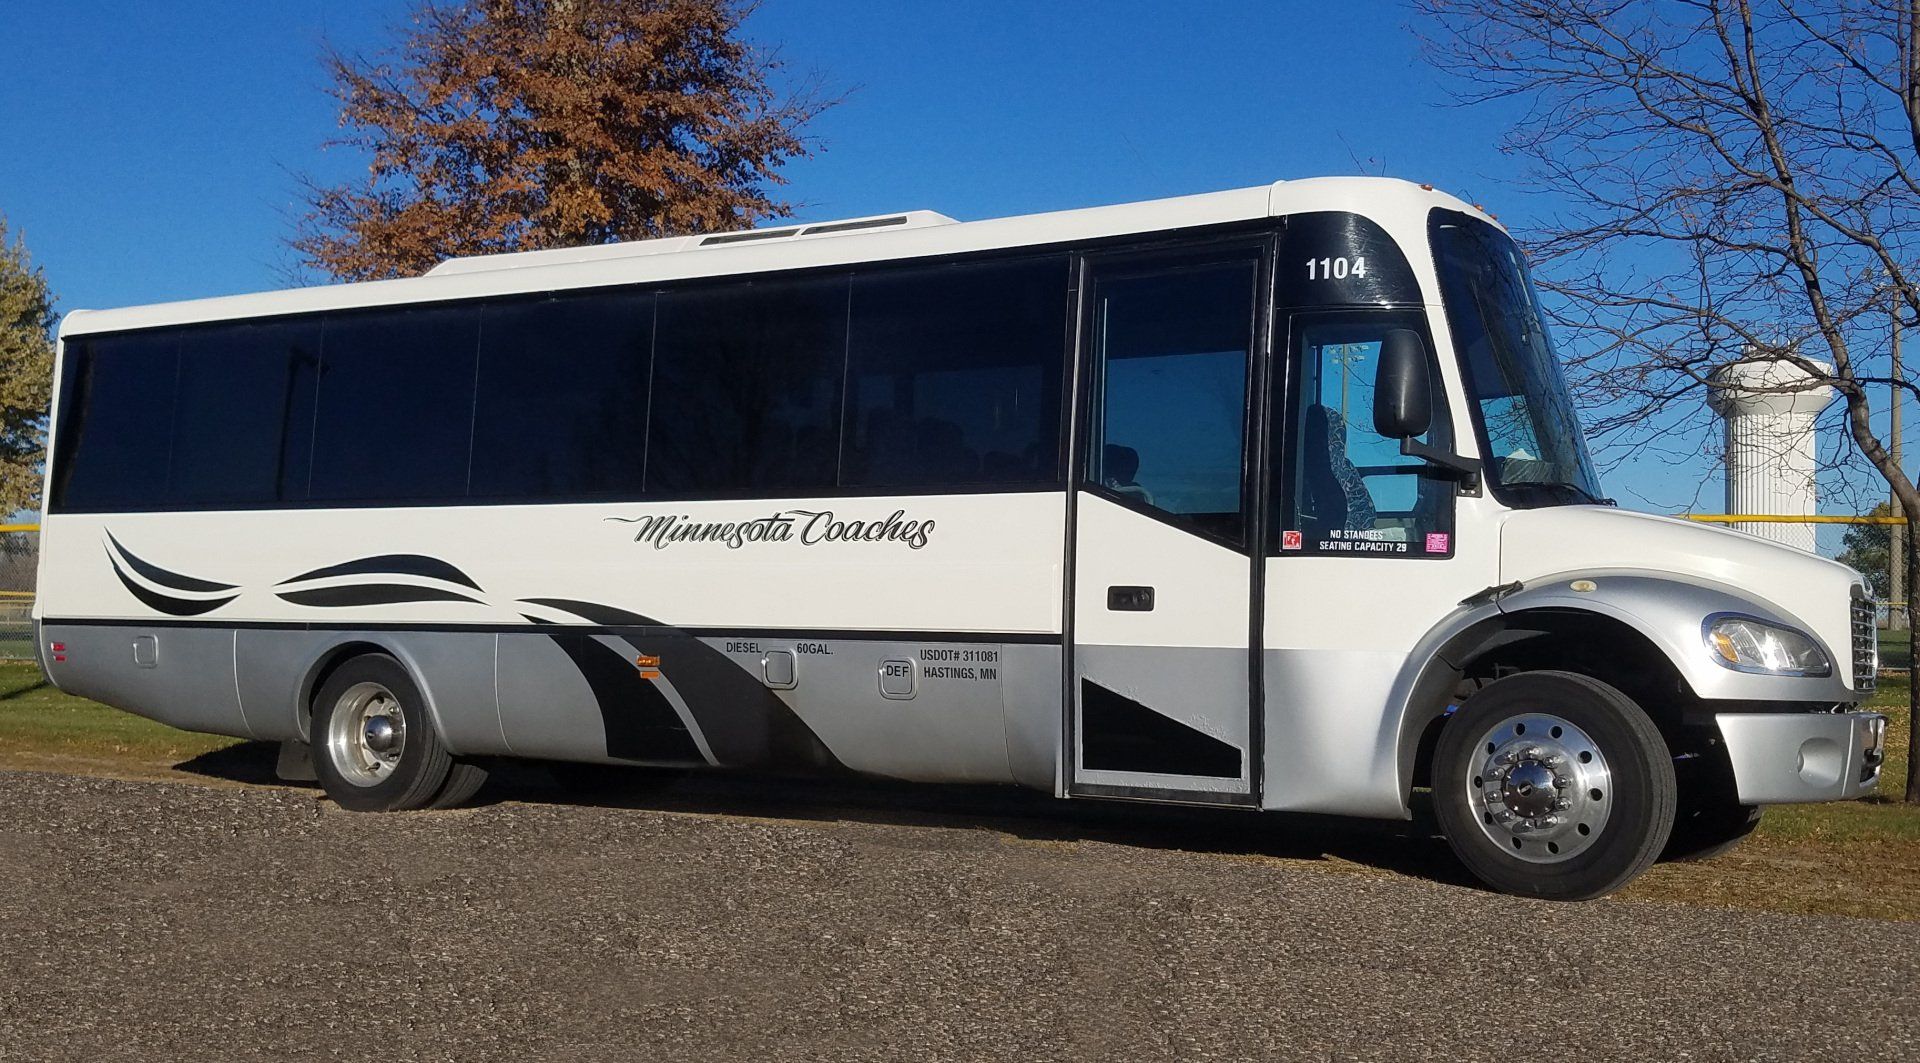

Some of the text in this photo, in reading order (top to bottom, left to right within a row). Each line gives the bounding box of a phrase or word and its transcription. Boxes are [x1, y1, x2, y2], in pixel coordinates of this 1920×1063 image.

[1306, 257, 1367, 280] 1104
[603, 509, 936, 550] Minnesota Coaches
[1330, 529, 1384, 540] NO STANDEES
[1319, 541, 1407, 552] SEATING CAPACITY 29
[726, 642, 762, 653] DIESEL
[797, 643, 834, 655] 60GAL.
[920, 649, 999, 663] USDOT# 311081
[886, 664, 909, 677] DEF
[923, 667, 997, 681] HASTINGS, MN
